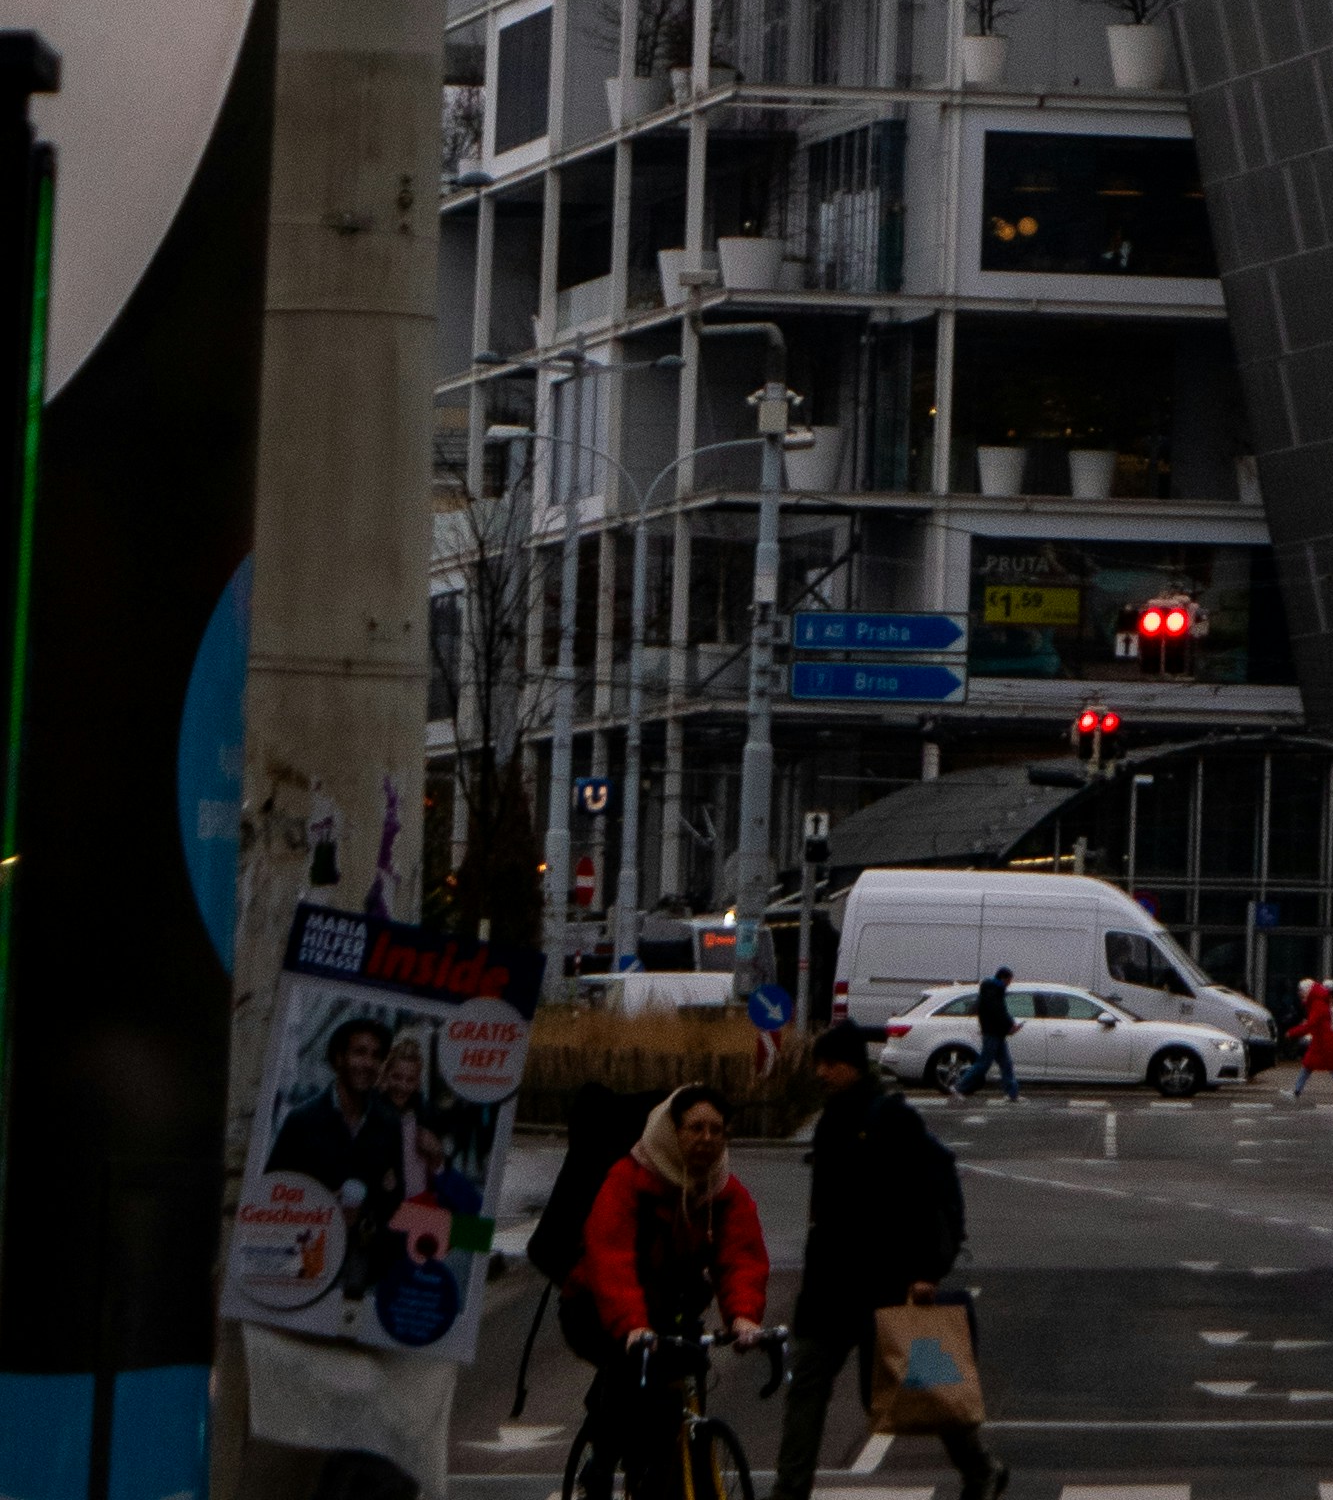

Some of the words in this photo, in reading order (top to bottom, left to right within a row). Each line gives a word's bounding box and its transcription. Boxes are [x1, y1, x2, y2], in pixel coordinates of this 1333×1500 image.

[857, 621, 911, 642] Praha
[854, 671, 899, 692] Brno
[582, 784, 608, 812] U
[305, 911, 368, 939] MARIA
[301, 928, 367, 956] HILFER
[364, 929, 512, 999] Inside
[460, 1049, 510, 1069] HEFT
[270, 1183, 304, 1204] Das
